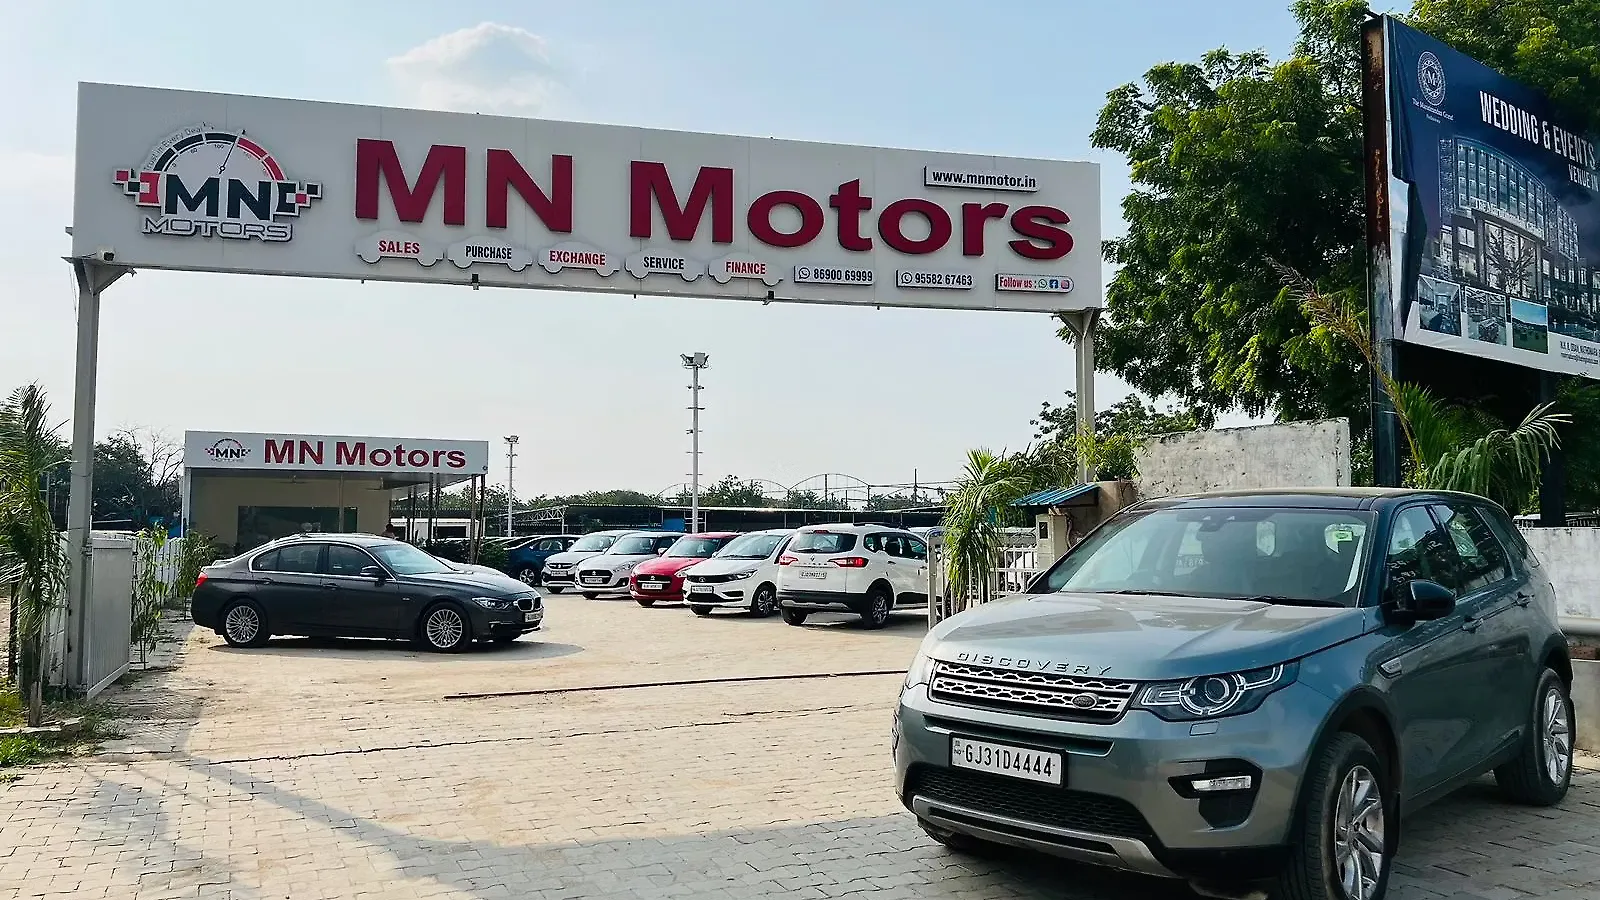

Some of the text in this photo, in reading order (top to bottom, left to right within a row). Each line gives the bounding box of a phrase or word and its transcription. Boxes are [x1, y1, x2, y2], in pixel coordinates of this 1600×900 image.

[1480, 90, 1595, 170] WEDDING & EVENTS
[932, 169, 1036, 188] www.mnmotor.in
[1568, 163, 1590, 188] VENUE
[165, 174, 272, 220] MN
[355, 138, 1074, 260] MN Motors
[143, 217, 293, 242] MOTORS
[378, 240, 421, 254] SALES
[465, 245, 512, 260] PURCHASE
[549, 250, 606, 266] EXCHANGE
[643, 256, 685, 270] SERVICE
[725, 261, 766, 275] FINANCE
[813, 268, 872, 281] 86900 69999
[915, 272, 973, 286] 95582 67463
[1000, 276, 1022, 288] Follow
[264, 439, 466, 468] MN Motors
[957, 652, 1112, 676] DISCOVERY
[965, 744, 1052, 777] GJ31D4444
